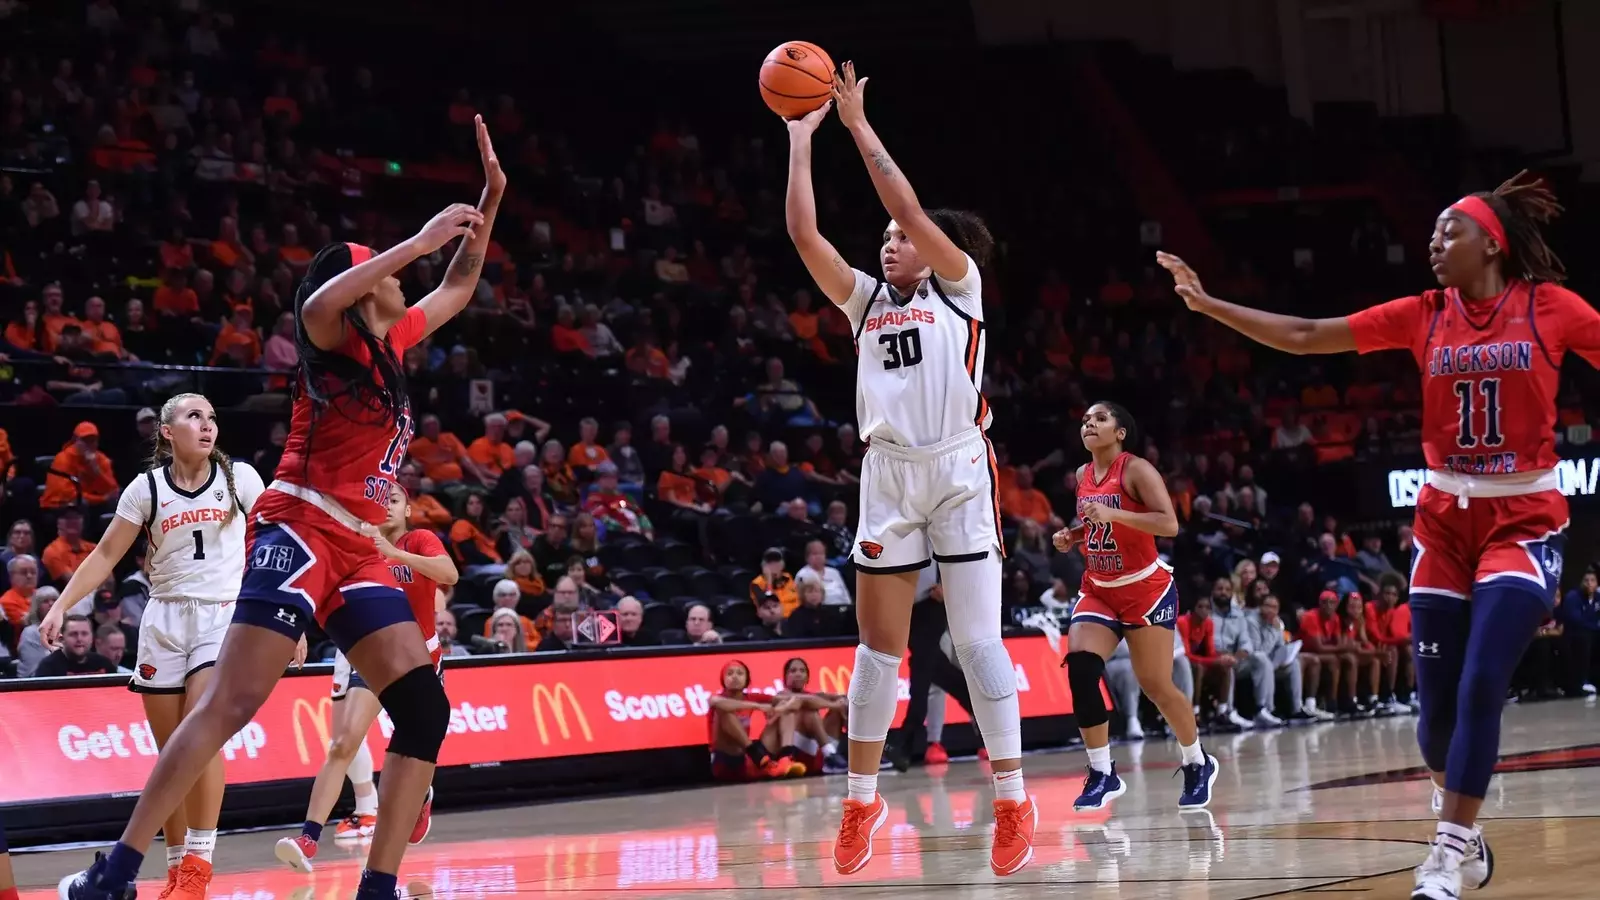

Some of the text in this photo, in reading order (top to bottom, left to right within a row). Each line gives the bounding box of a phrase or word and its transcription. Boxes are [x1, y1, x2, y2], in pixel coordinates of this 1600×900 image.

[878, 327, 923, 370] 30
[1429, 341, 1532, 377] JACKSON
[1453, 377, 1505, 449] 11
[192, 530, 205, 560] 1
[1082, 516, 1118, 551] 22
[58, 724, 131, 761] Get
[604, 689, 687, 722] Score
